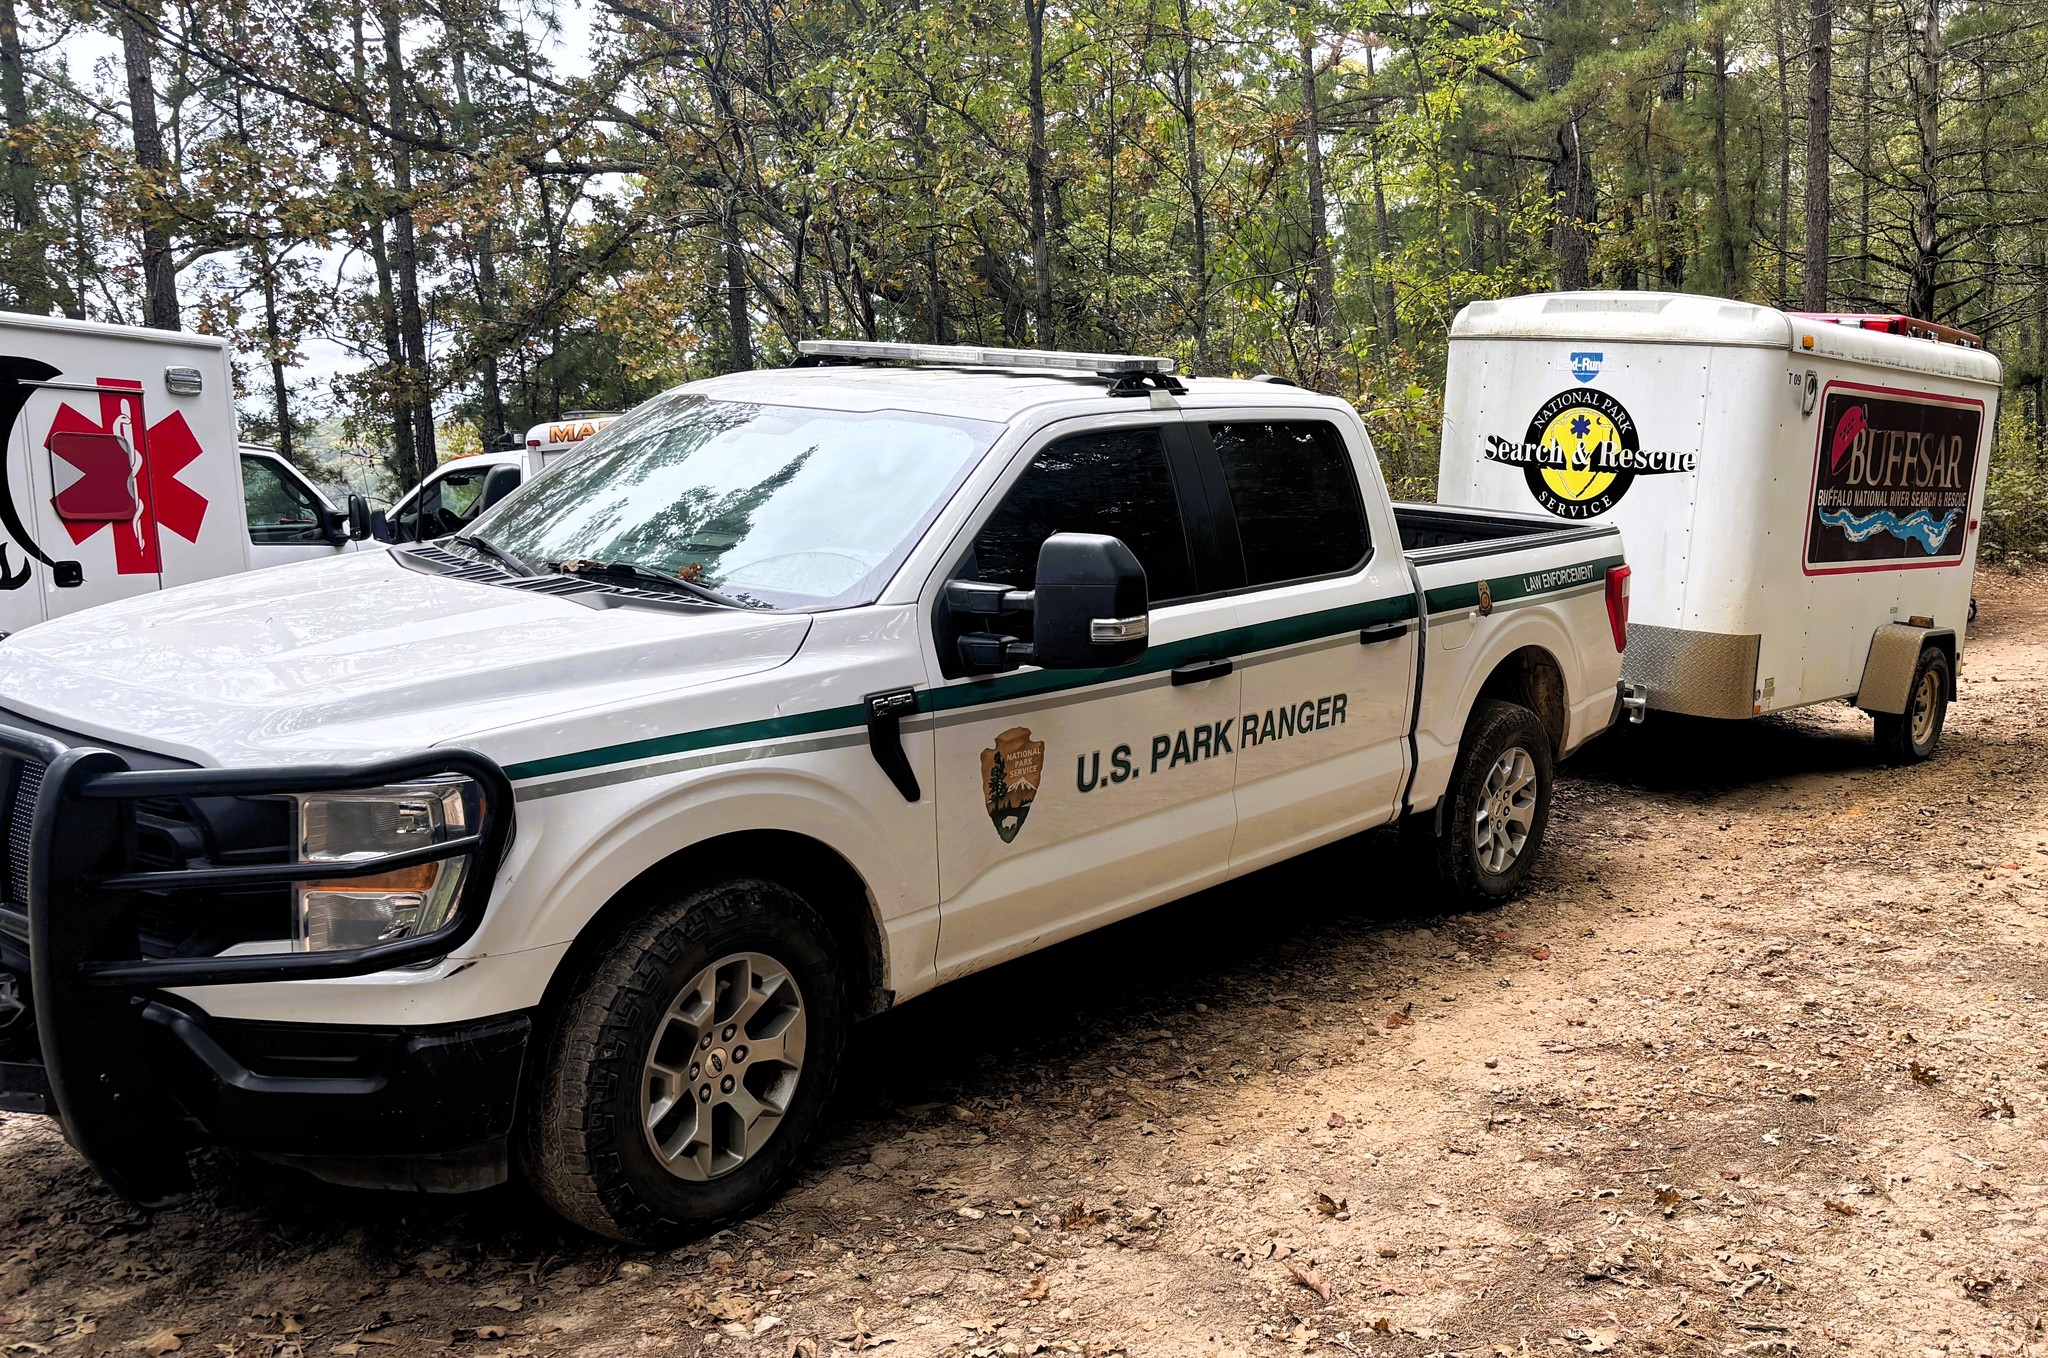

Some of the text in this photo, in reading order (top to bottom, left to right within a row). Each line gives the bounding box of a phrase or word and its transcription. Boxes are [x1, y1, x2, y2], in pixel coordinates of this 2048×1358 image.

[1788, 372, 1794, 385] T
[1534, 391, 1632, 435] NATIONAL PARK
[1485, 434, 1698, 472] Search & Rescue
[1846, 428, 1963, 488] BUFFSAR
[1539, 490, 1612, 517] SERVICE
[1817, 489, 1967, 507] BUFFALO NATIONAL RIVER SEARCH & RESCUE
[1523, 565, 1593, 592] LAW ENFORCEMENT
[1006, 747, 1041, 761] NATIONAL
[1076, 693, 1348, 793] U.S. PARK RANGER
[1009, 765, 1038, 778] SERVICE
[1014, 757, 1033, 768] PARK
